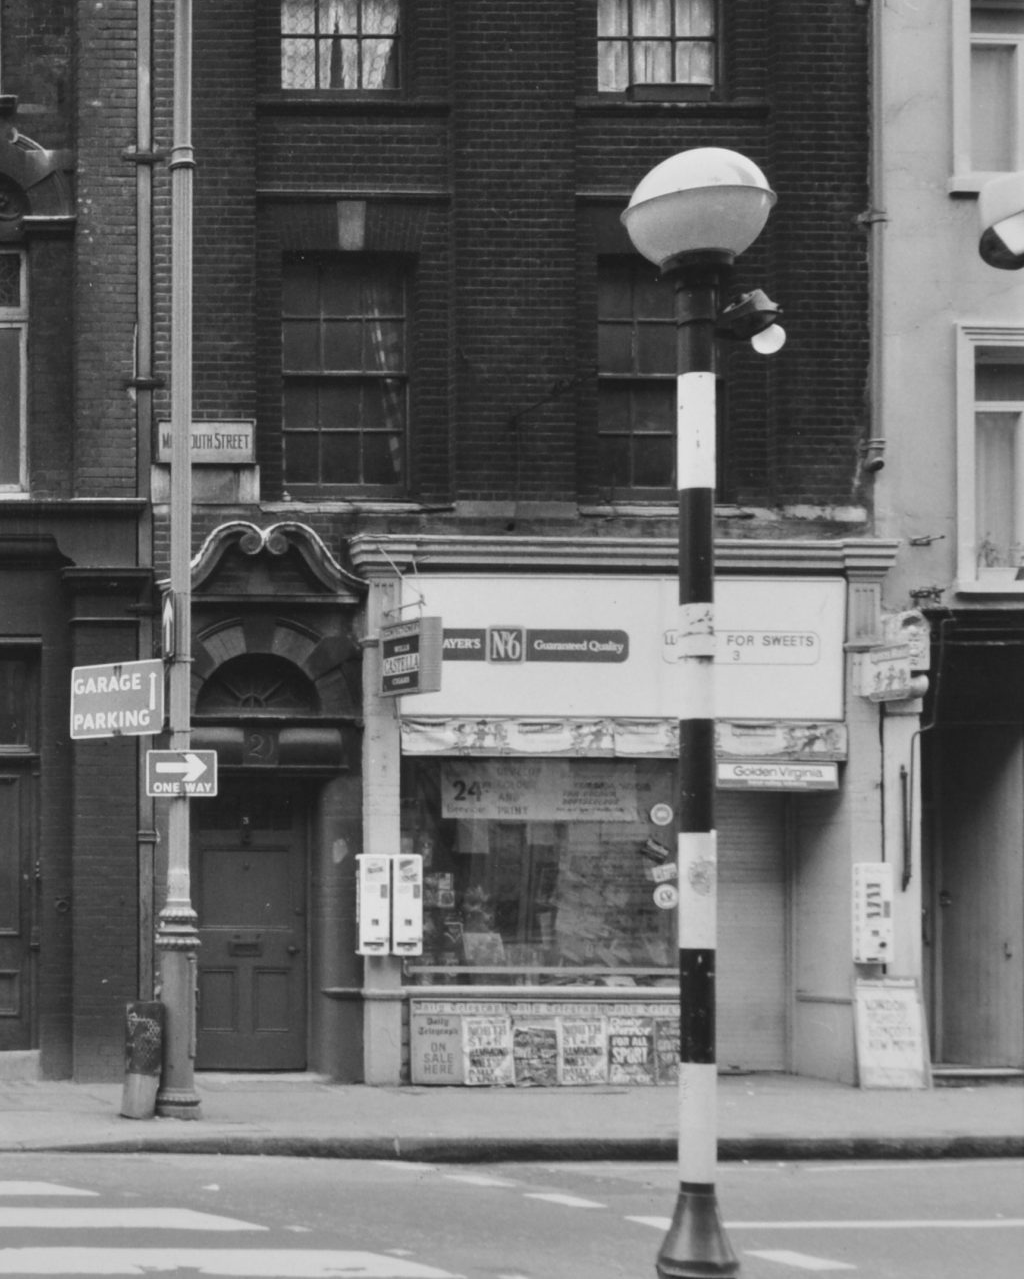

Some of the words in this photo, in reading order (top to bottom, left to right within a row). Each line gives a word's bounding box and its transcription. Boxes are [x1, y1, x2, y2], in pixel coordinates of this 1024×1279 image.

[533, 639, 587, 651] Guaranteed
[588, 640, 624, 654] Quality
[727, 634, 754, 646] FOR
[762, 634, 814, 647] SWEETS
[383, 653, 419, 676] CASTELLA
[74, 673, 142, 695] GARAGE
[74, 709, 150, 731] PARKING
[733, 765, 775, 777] Golden
[777, 766, 823, 781] Virginia
[153, 782, 181, 793] ONE
[184, 782, 212, 793] WAY
[423, 1053, 454, 1063] SALE
[423, 1064, 454, 1075] HERE
